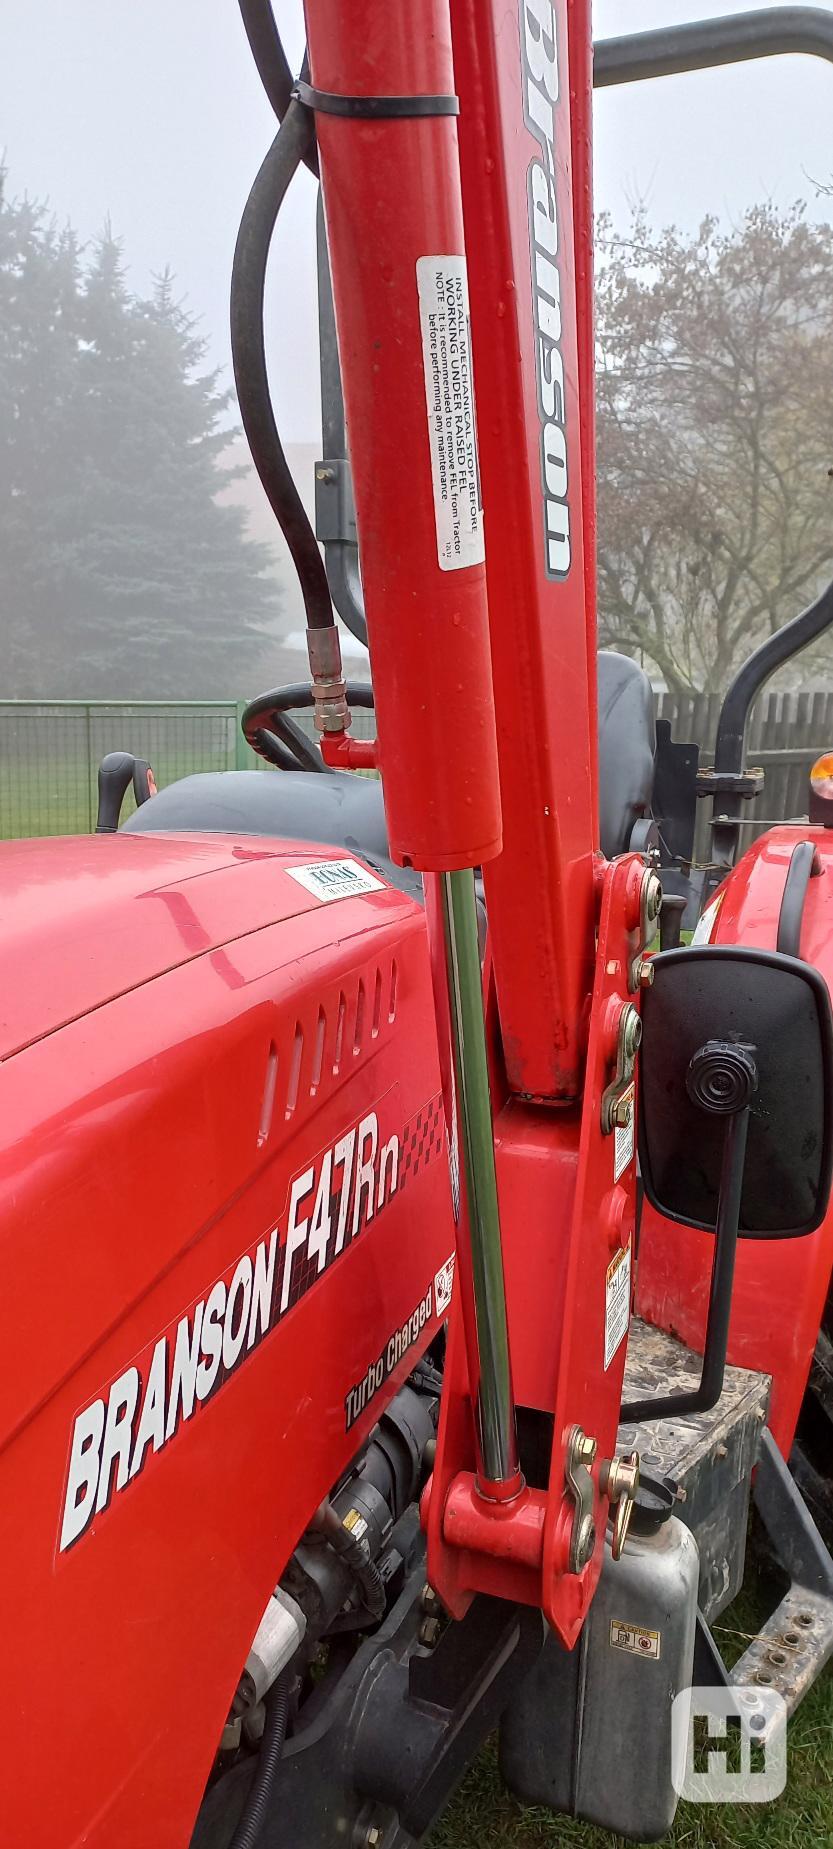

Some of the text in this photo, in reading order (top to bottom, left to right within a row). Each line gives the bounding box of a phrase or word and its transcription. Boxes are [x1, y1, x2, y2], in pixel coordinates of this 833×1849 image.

[435, 271, 445, 303] NOTE
[523, 0, 572, 574] Branson
[428, 313, 437, 350] before
[438, 313, 446, 321] It
[439, 324, 446, 332] is
[430, 352, 442, 412] performing
[440, 335, 452, 413] recommended
[446, 277, 467, 494] WORKING UNDER RAISED FEL
[445, 416, 452, 428] to
[455, 277, 478, 533] INSTALL MECHANICAL STOP BEFORE
[434, 414, 443, 434] any
[449, 473, 457, 491] FEL
[453, 519, 461, 555] Tractor
[58, 1111, 400, 1553] BRANSON F47Rn
[346, 1285, 432, 1428] Turbo Charged
